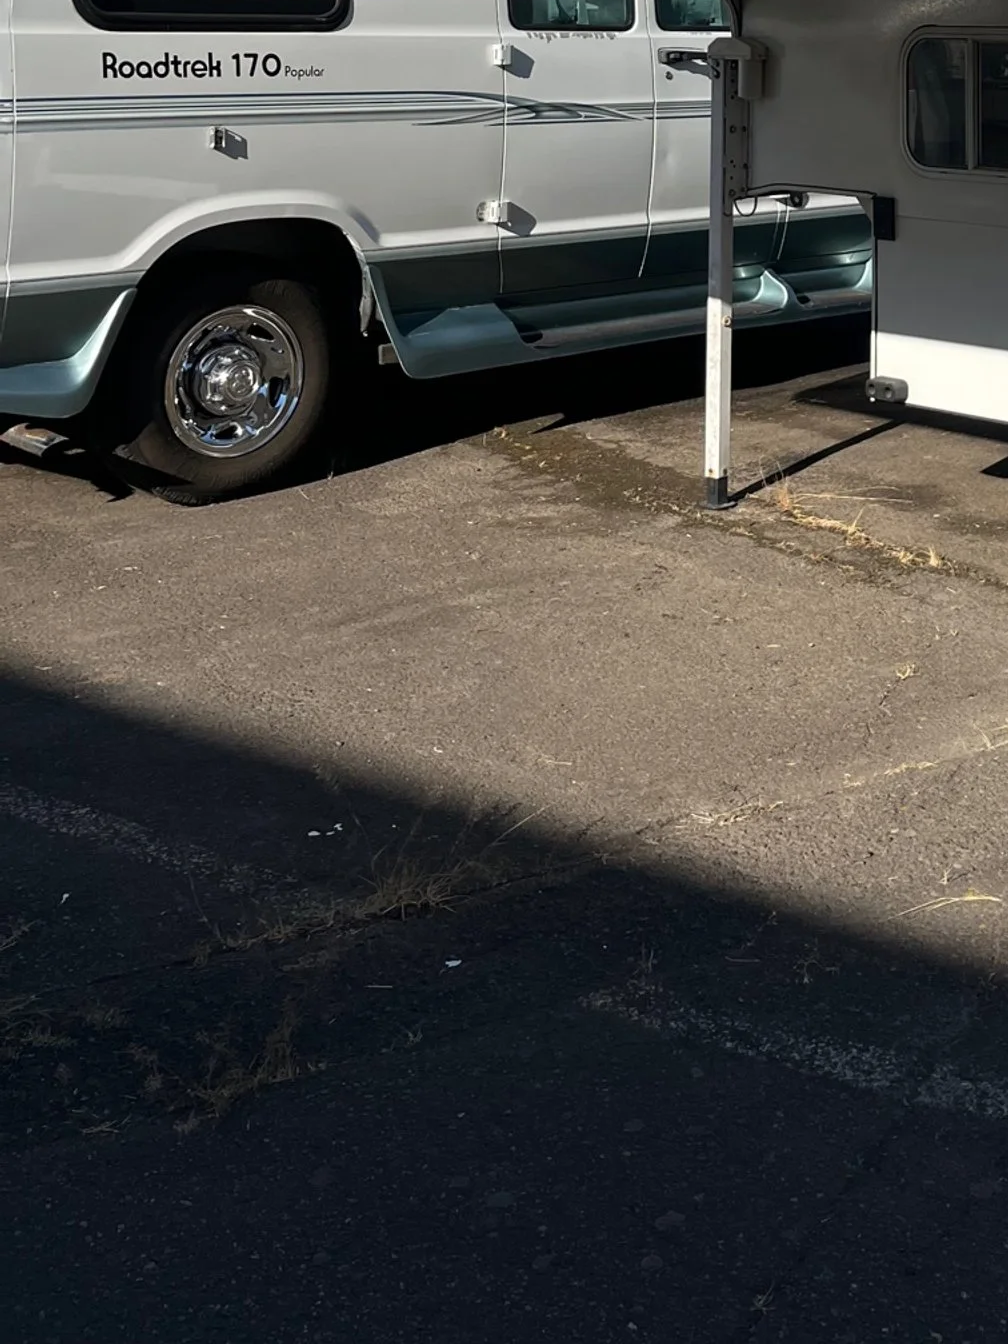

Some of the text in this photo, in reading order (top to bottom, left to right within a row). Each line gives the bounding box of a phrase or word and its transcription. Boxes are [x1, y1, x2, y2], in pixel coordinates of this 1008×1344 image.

[102, 52, 325, 81] Roadtrek 170 Popular
